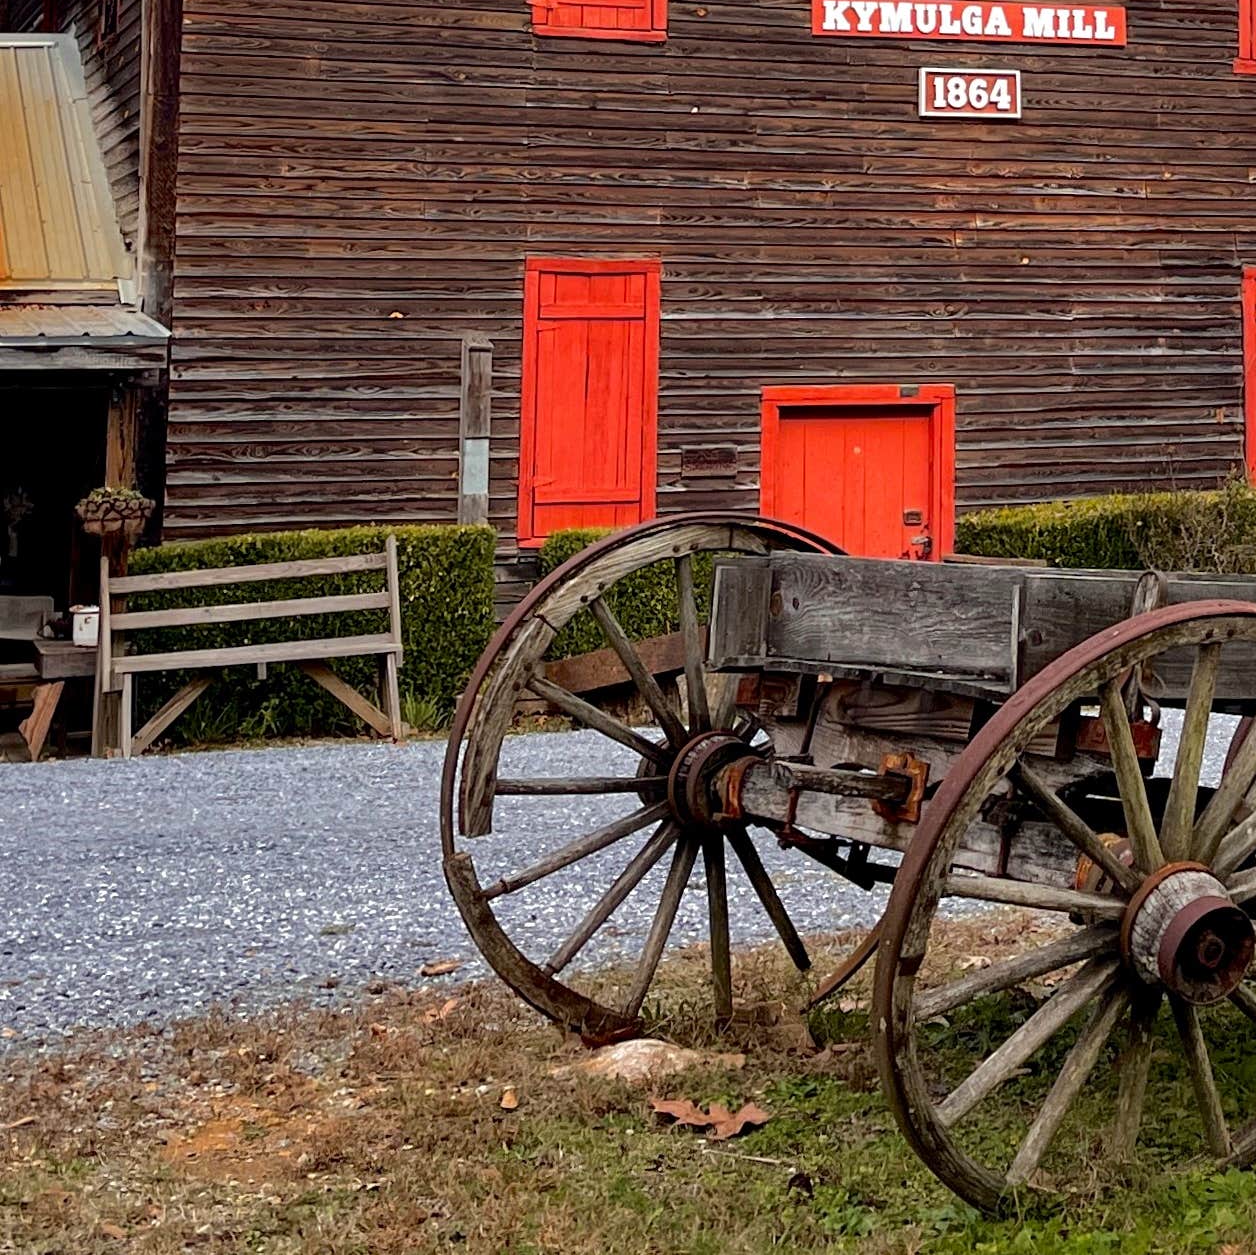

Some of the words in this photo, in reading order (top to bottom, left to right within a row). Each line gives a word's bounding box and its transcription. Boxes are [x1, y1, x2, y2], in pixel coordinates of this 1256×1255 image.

[822, 0, 1012, 36] KYMULGA
[1023, 7, 1116, 40] MILL
[933, 76, 1012, 110] 1864
